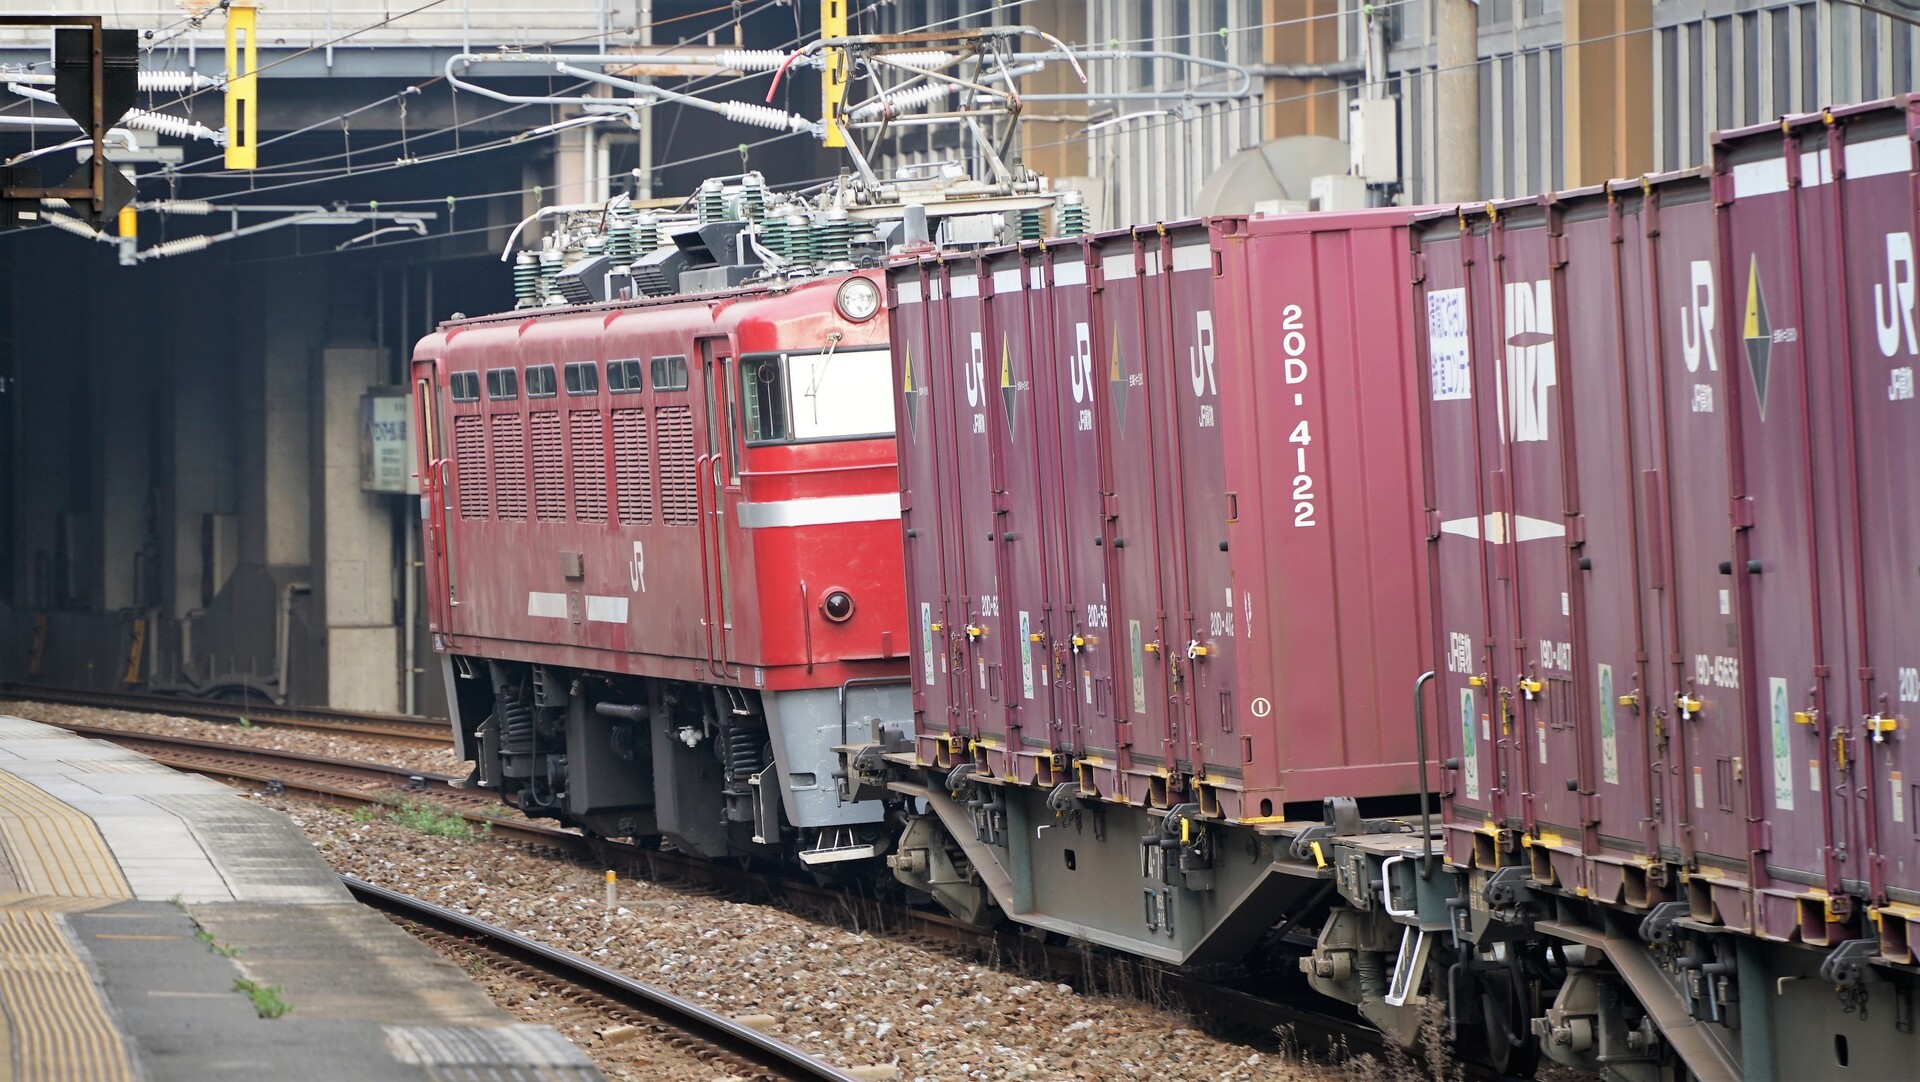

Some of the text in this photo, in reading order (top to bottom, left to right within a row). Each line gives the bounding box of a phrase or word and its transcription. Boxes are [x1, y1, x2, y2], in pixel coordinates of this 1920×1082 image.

[1681, 260, 1718, 373] JR
[1875, 231, 1919, 357] JR
[965, 332, 986, 408] JR
[1070, 322, 1094, 404] JR
[1190, 310, 1217, 398] JR
[1282, 304, 1316, 528] 20D-4122
[629, 541, 646, 592] JR
[1899, 667, 1920, 702] 20D
